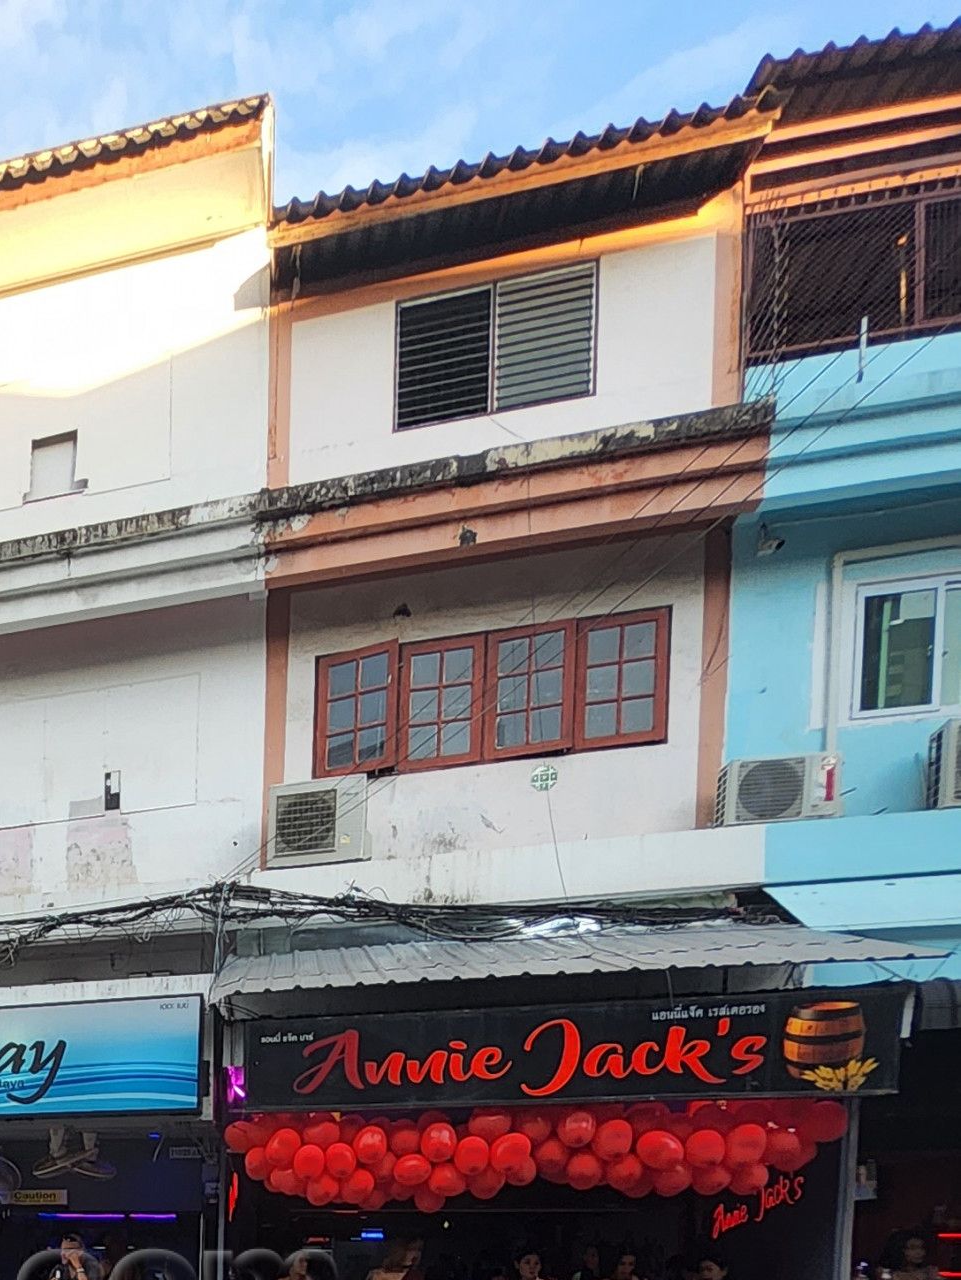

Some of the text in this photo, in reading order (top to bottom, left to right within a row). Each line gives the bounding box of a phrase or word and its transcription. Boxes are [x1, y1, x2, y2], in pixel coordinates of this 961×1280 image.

[293, 1018, 767, 1097] Annie Jack's
[13, 1191, 57, 1201] Caution
